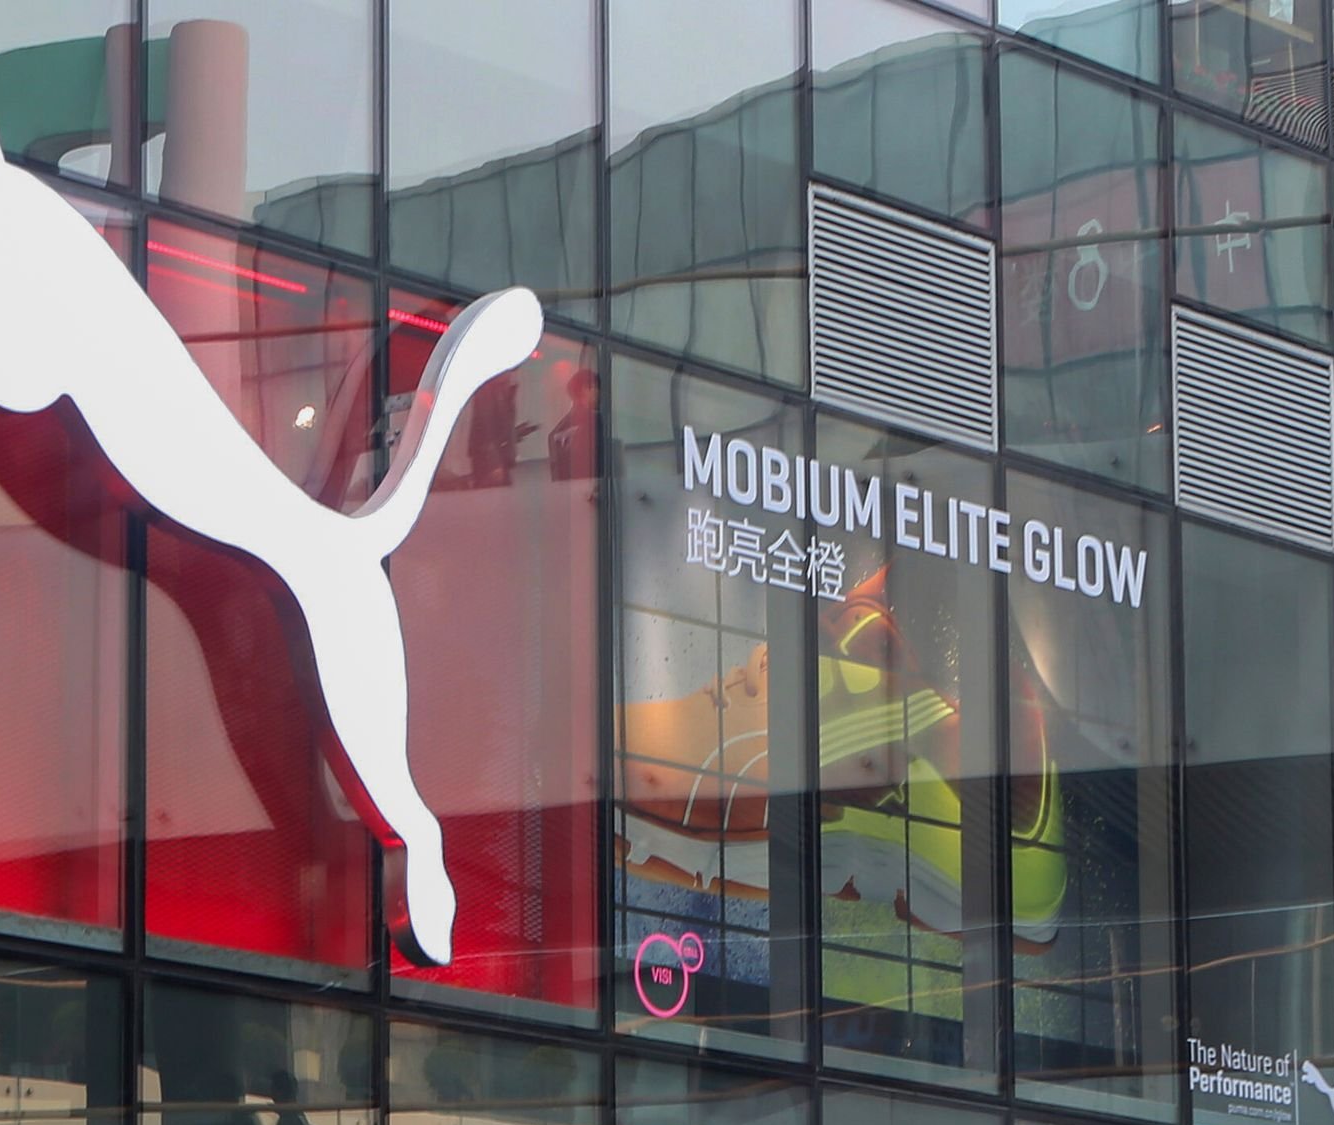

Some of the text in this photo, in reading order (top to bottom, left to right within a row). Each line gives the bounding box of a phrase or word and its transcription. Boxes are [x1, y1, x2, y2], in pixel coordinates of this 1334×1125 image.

[683, 425, 1147, 608] MOBIUM ELITE GLOW
[685, 507, 847, 602] 跑亮全橙
[1187, 1037, 1292, 1077] The Nature of
[1189, 1066, 1292, 1105] Performance
